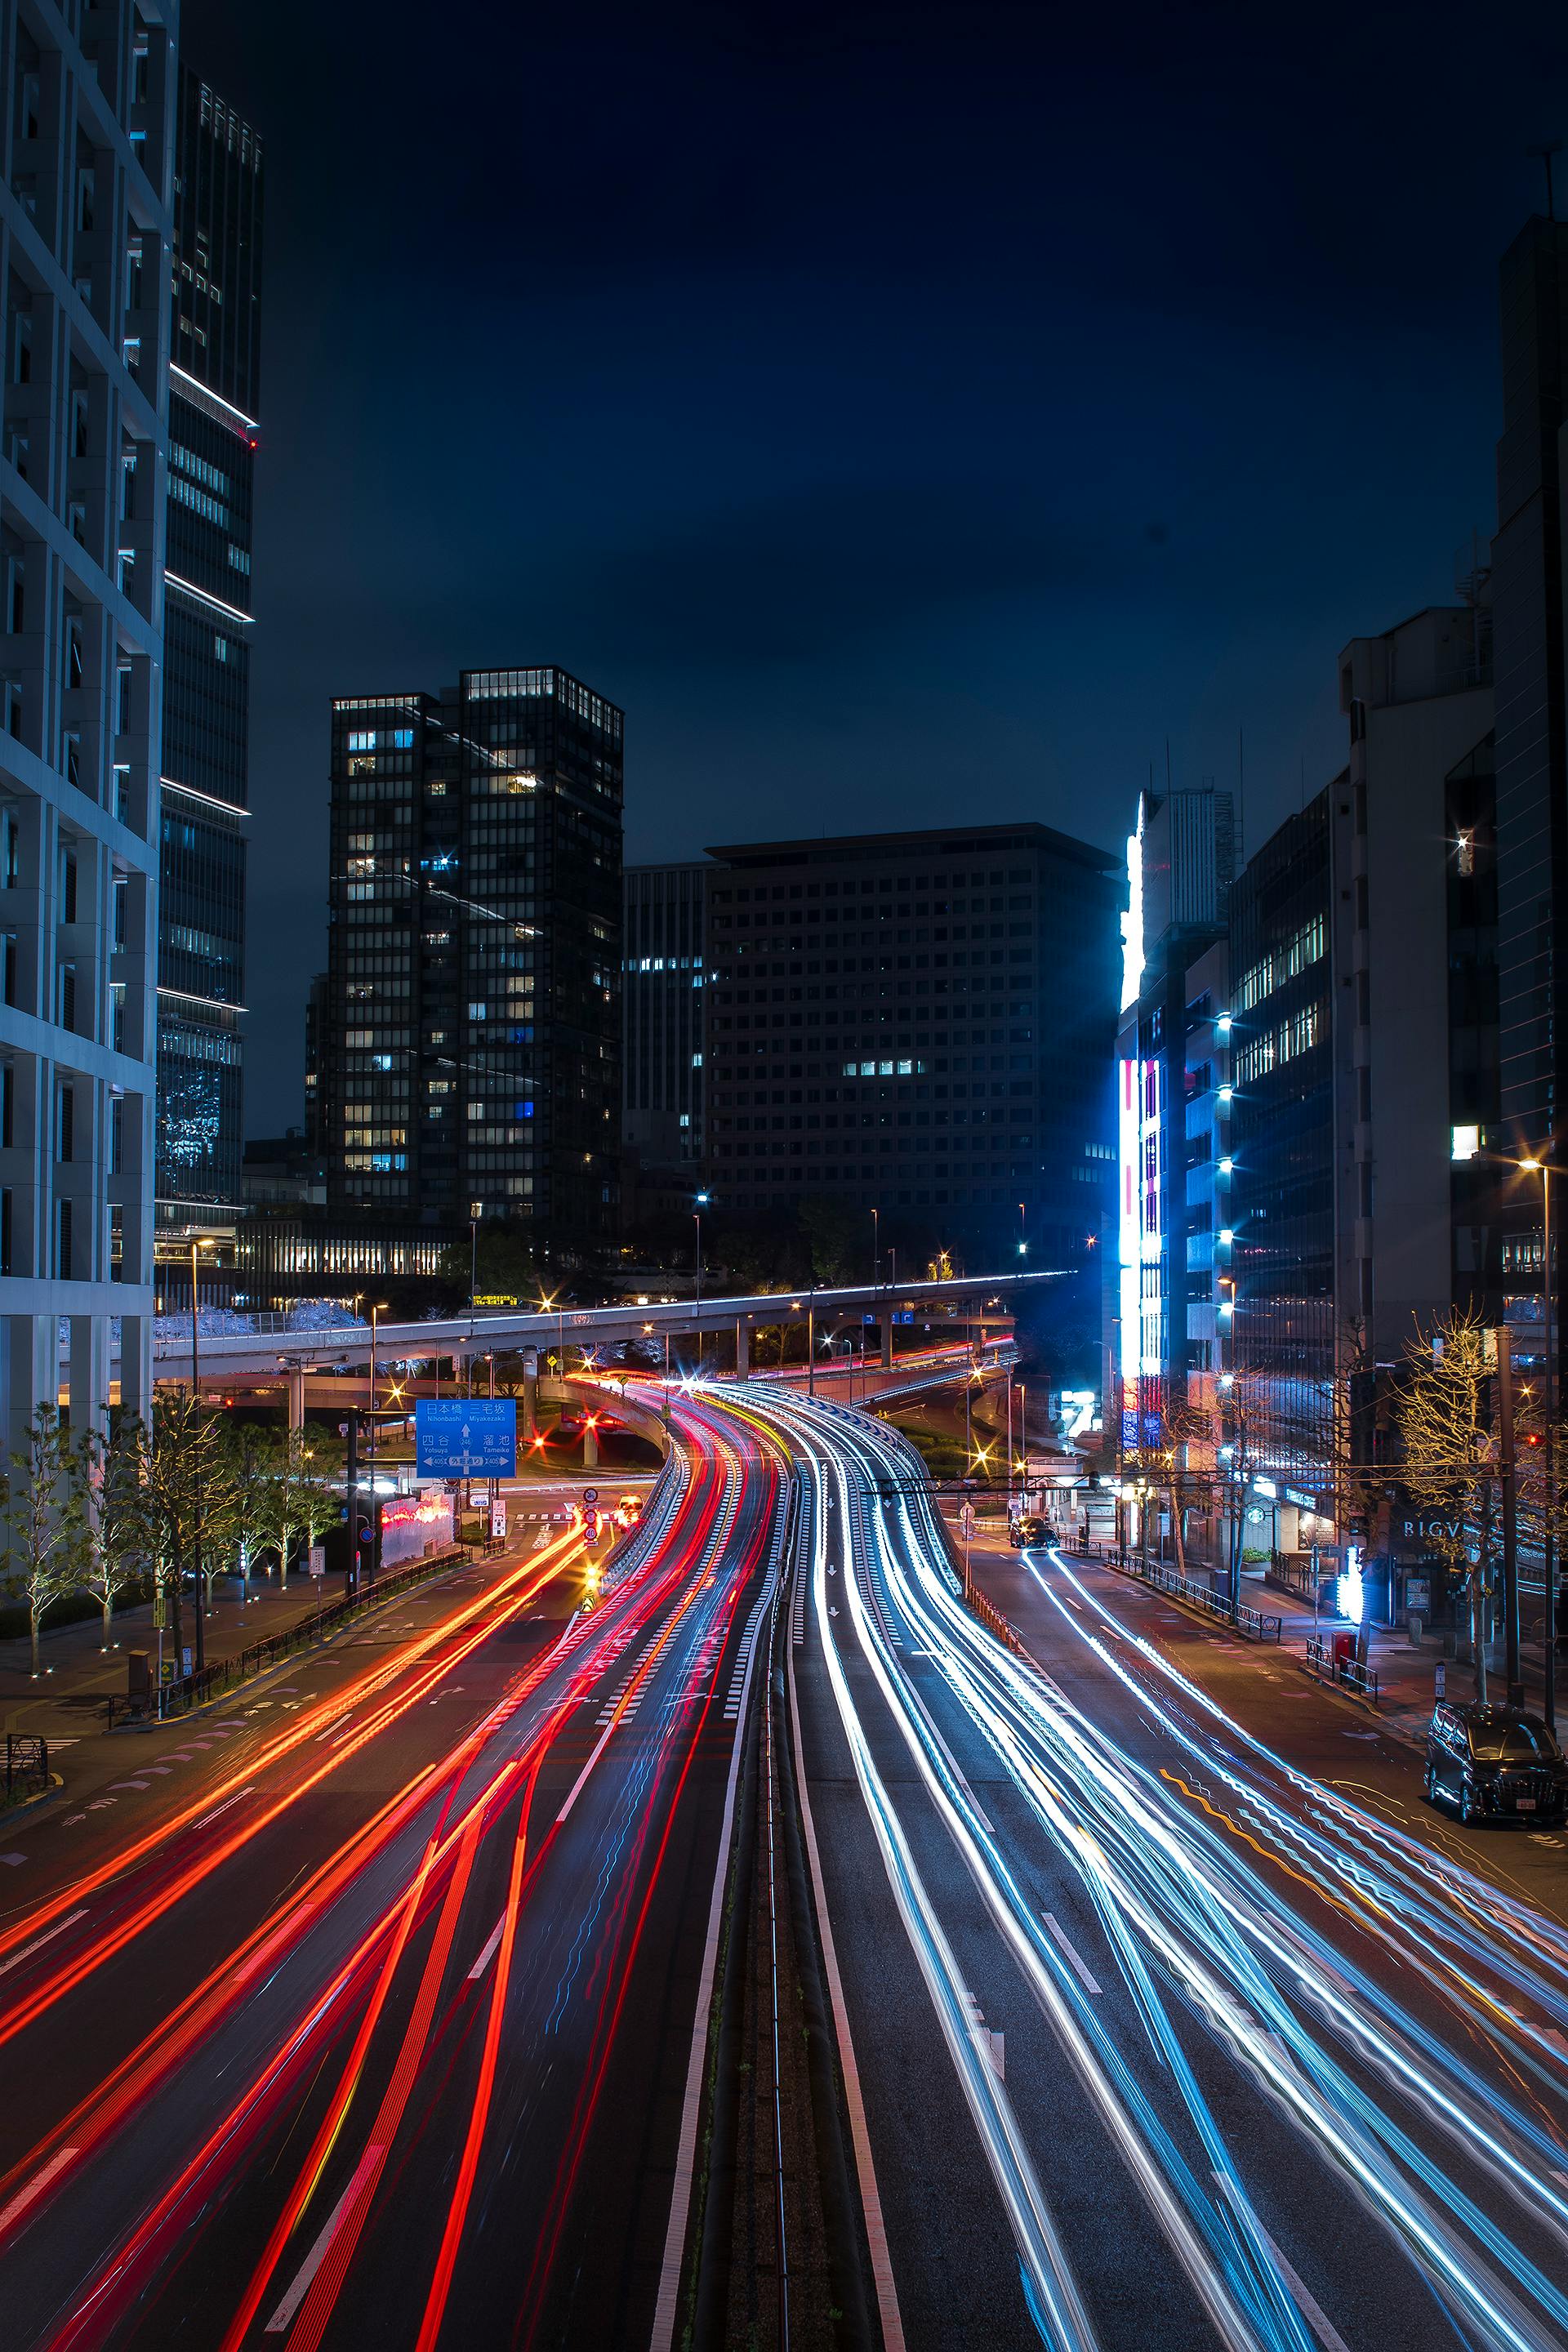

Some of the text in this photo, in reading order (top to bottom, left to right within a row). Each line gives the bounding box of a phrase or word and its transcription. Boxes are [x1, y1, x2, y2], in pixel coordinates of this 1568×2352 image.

[427, 1403, 506, 1414] 日本橋 三宅坂
[422, 1435, 450, 1446] 四谷
[483, 1434, 510, 1446] 溜池
